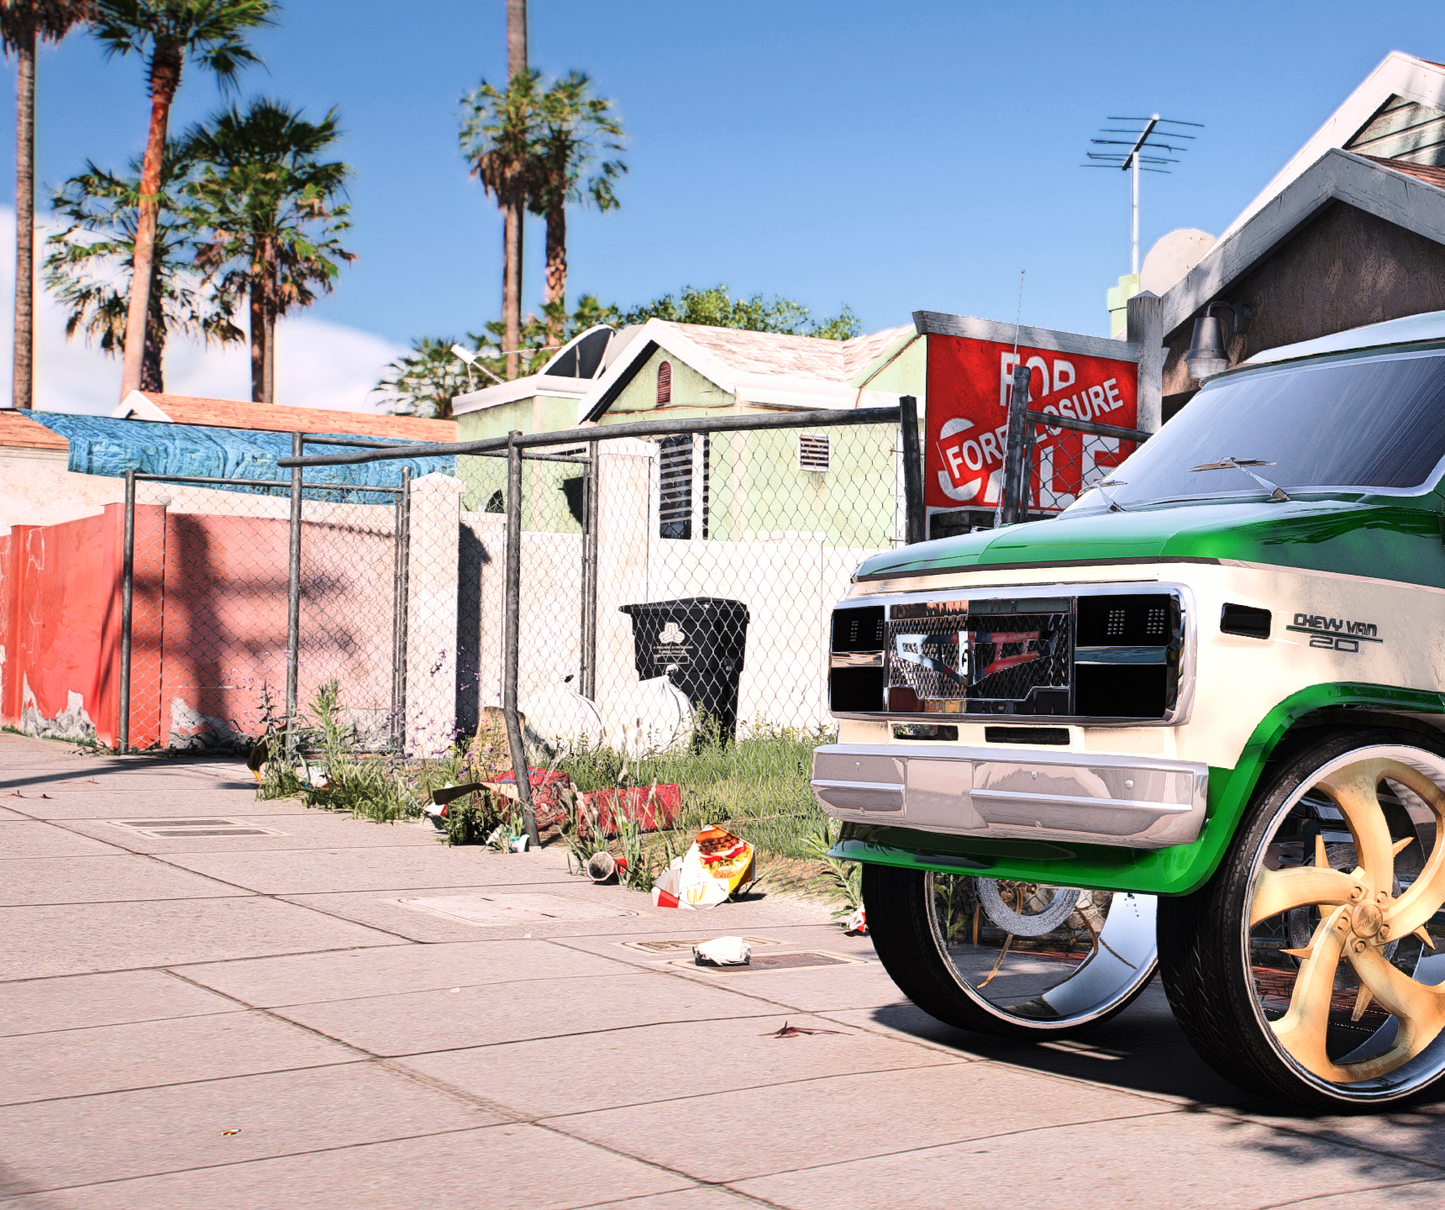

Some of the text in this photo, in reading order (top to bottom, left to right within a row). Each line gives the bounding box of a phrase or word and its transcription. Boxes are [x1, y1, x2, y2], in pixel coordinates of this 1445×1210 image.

[1000, 352, 1076, 407] FOR
[946, 377, 1123, 479] FORELOSURE
[1293, 613, 1343, 631] CHEVY
[1309, 635, 1359, 653] 20
